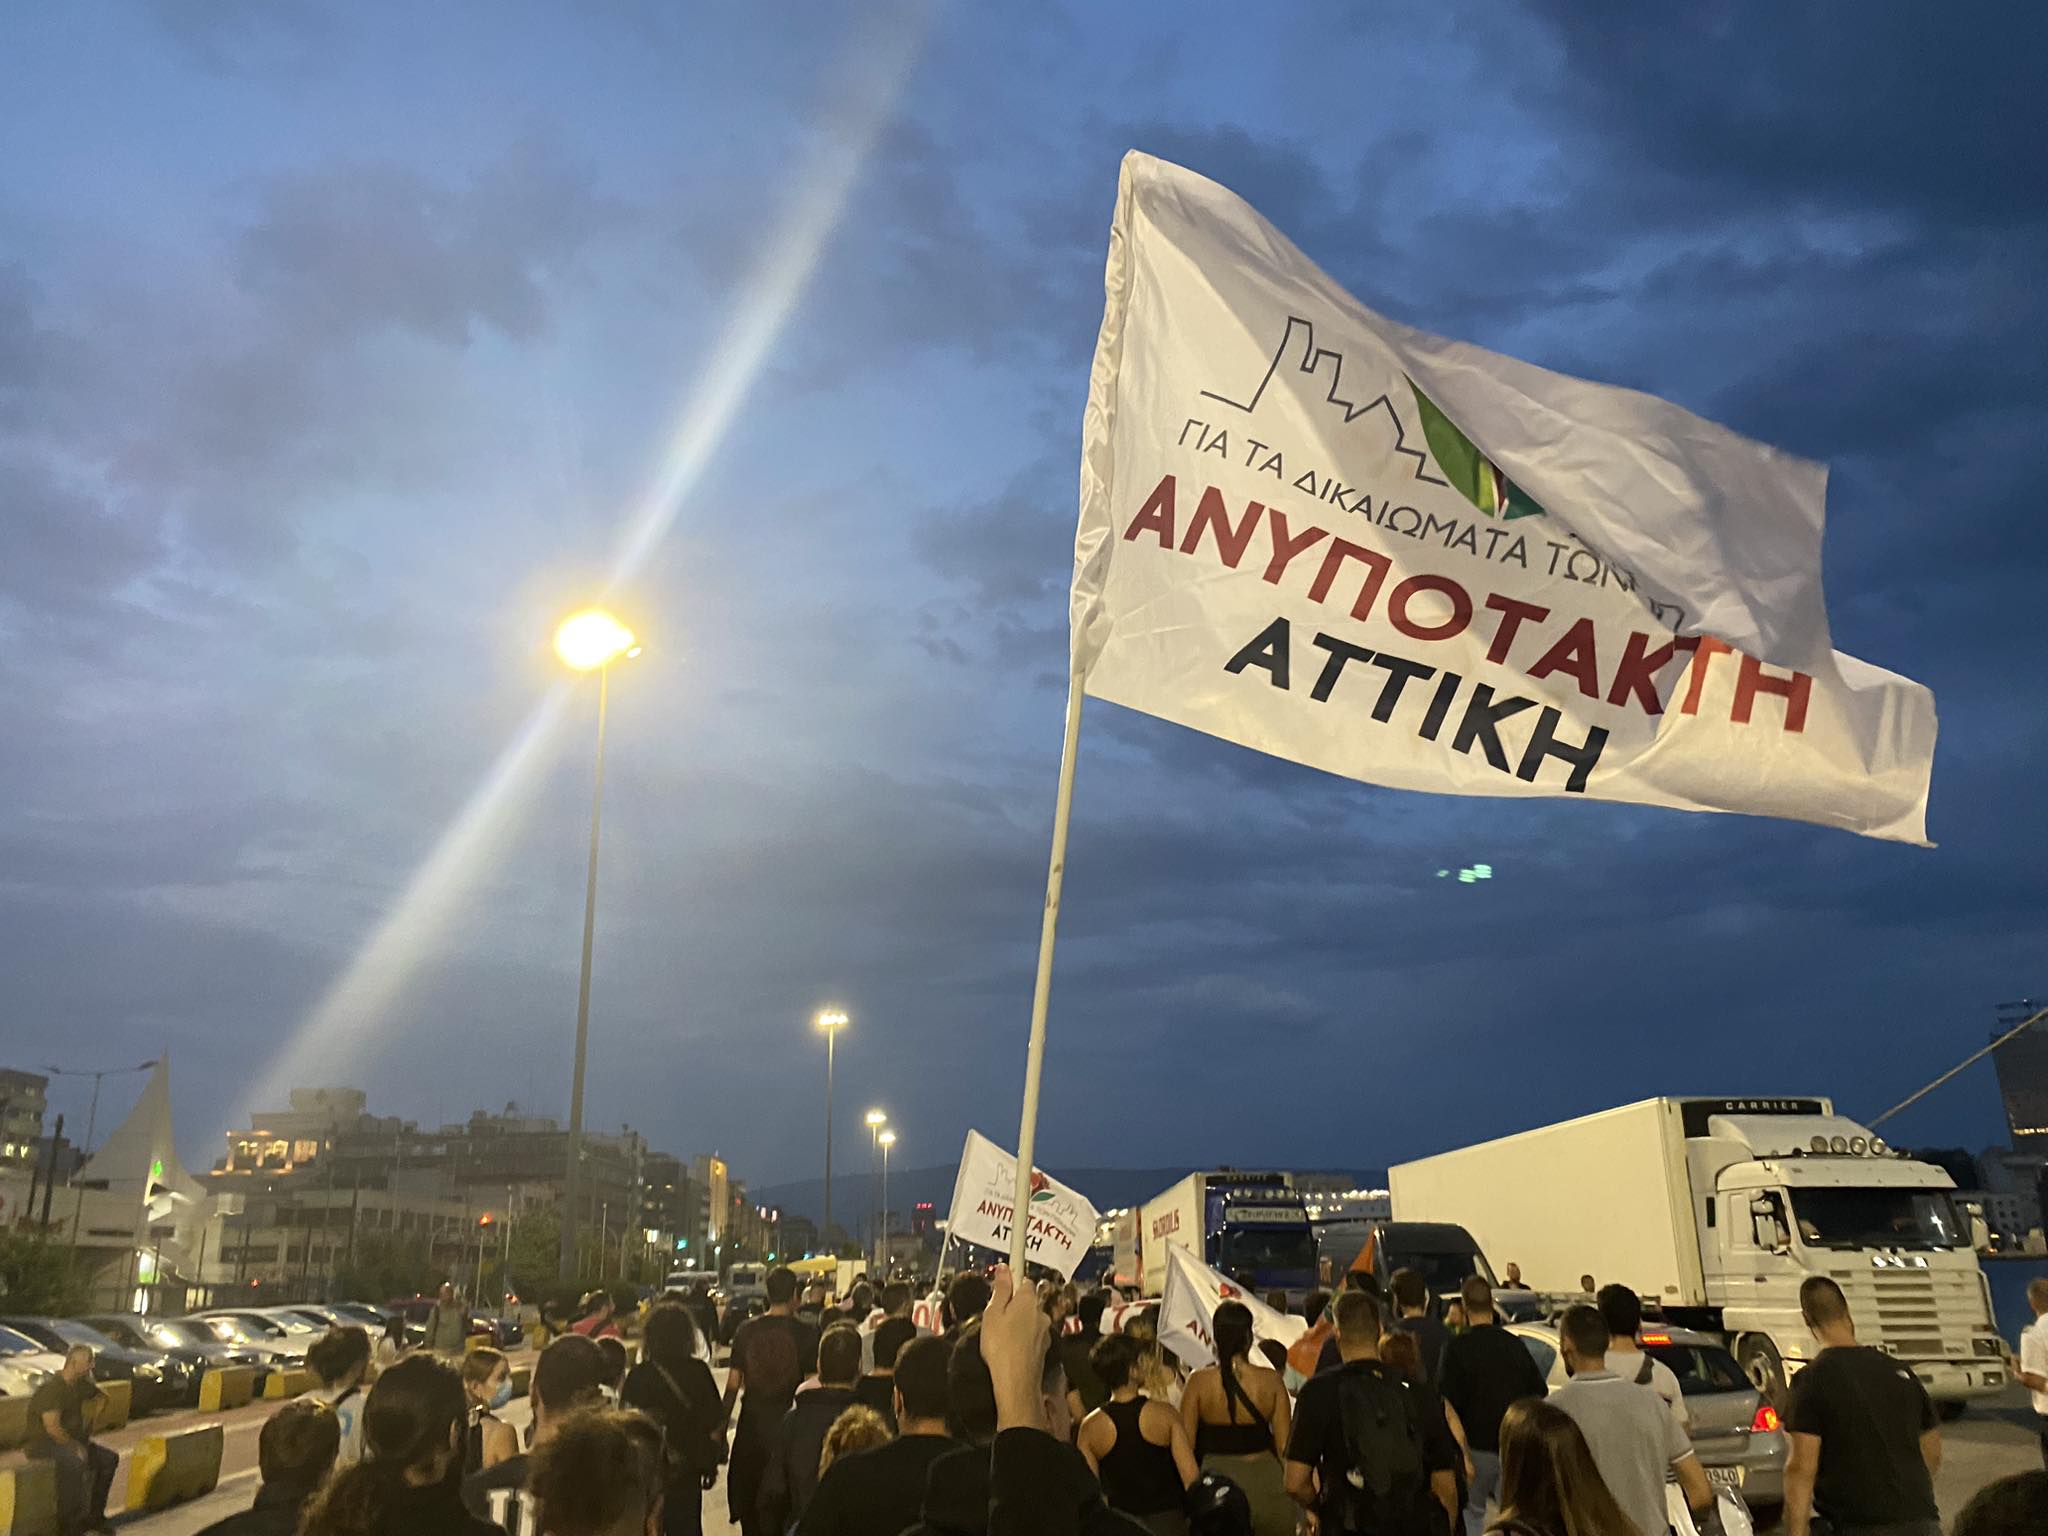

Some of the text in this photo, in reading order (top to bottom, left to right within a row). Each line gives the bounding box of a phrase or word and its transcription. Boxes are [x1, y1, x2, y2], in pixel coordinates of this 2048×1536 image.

[1177, 418, 1228, 459] ΓΙΑ
[1246, 439, 1284, 480] ΤΑ
[1292, 469, 1528, 569] ΔΙΚΑΙΩΜΑΤΑ
[1122, 474, 1812, 733] ΑΝΥΠΟΤΑΚΤΗ
[1223, 616, 1610, 793] ΑΤΤΙΚΗ
[1725, 1102, 1798, 1110] CARRIER
[976, 1199, 1072, 1250] ΑΝΥΠΤΑΚΤΗ
[992, 1223, 1043, 1252] ΑΤΚΗ
